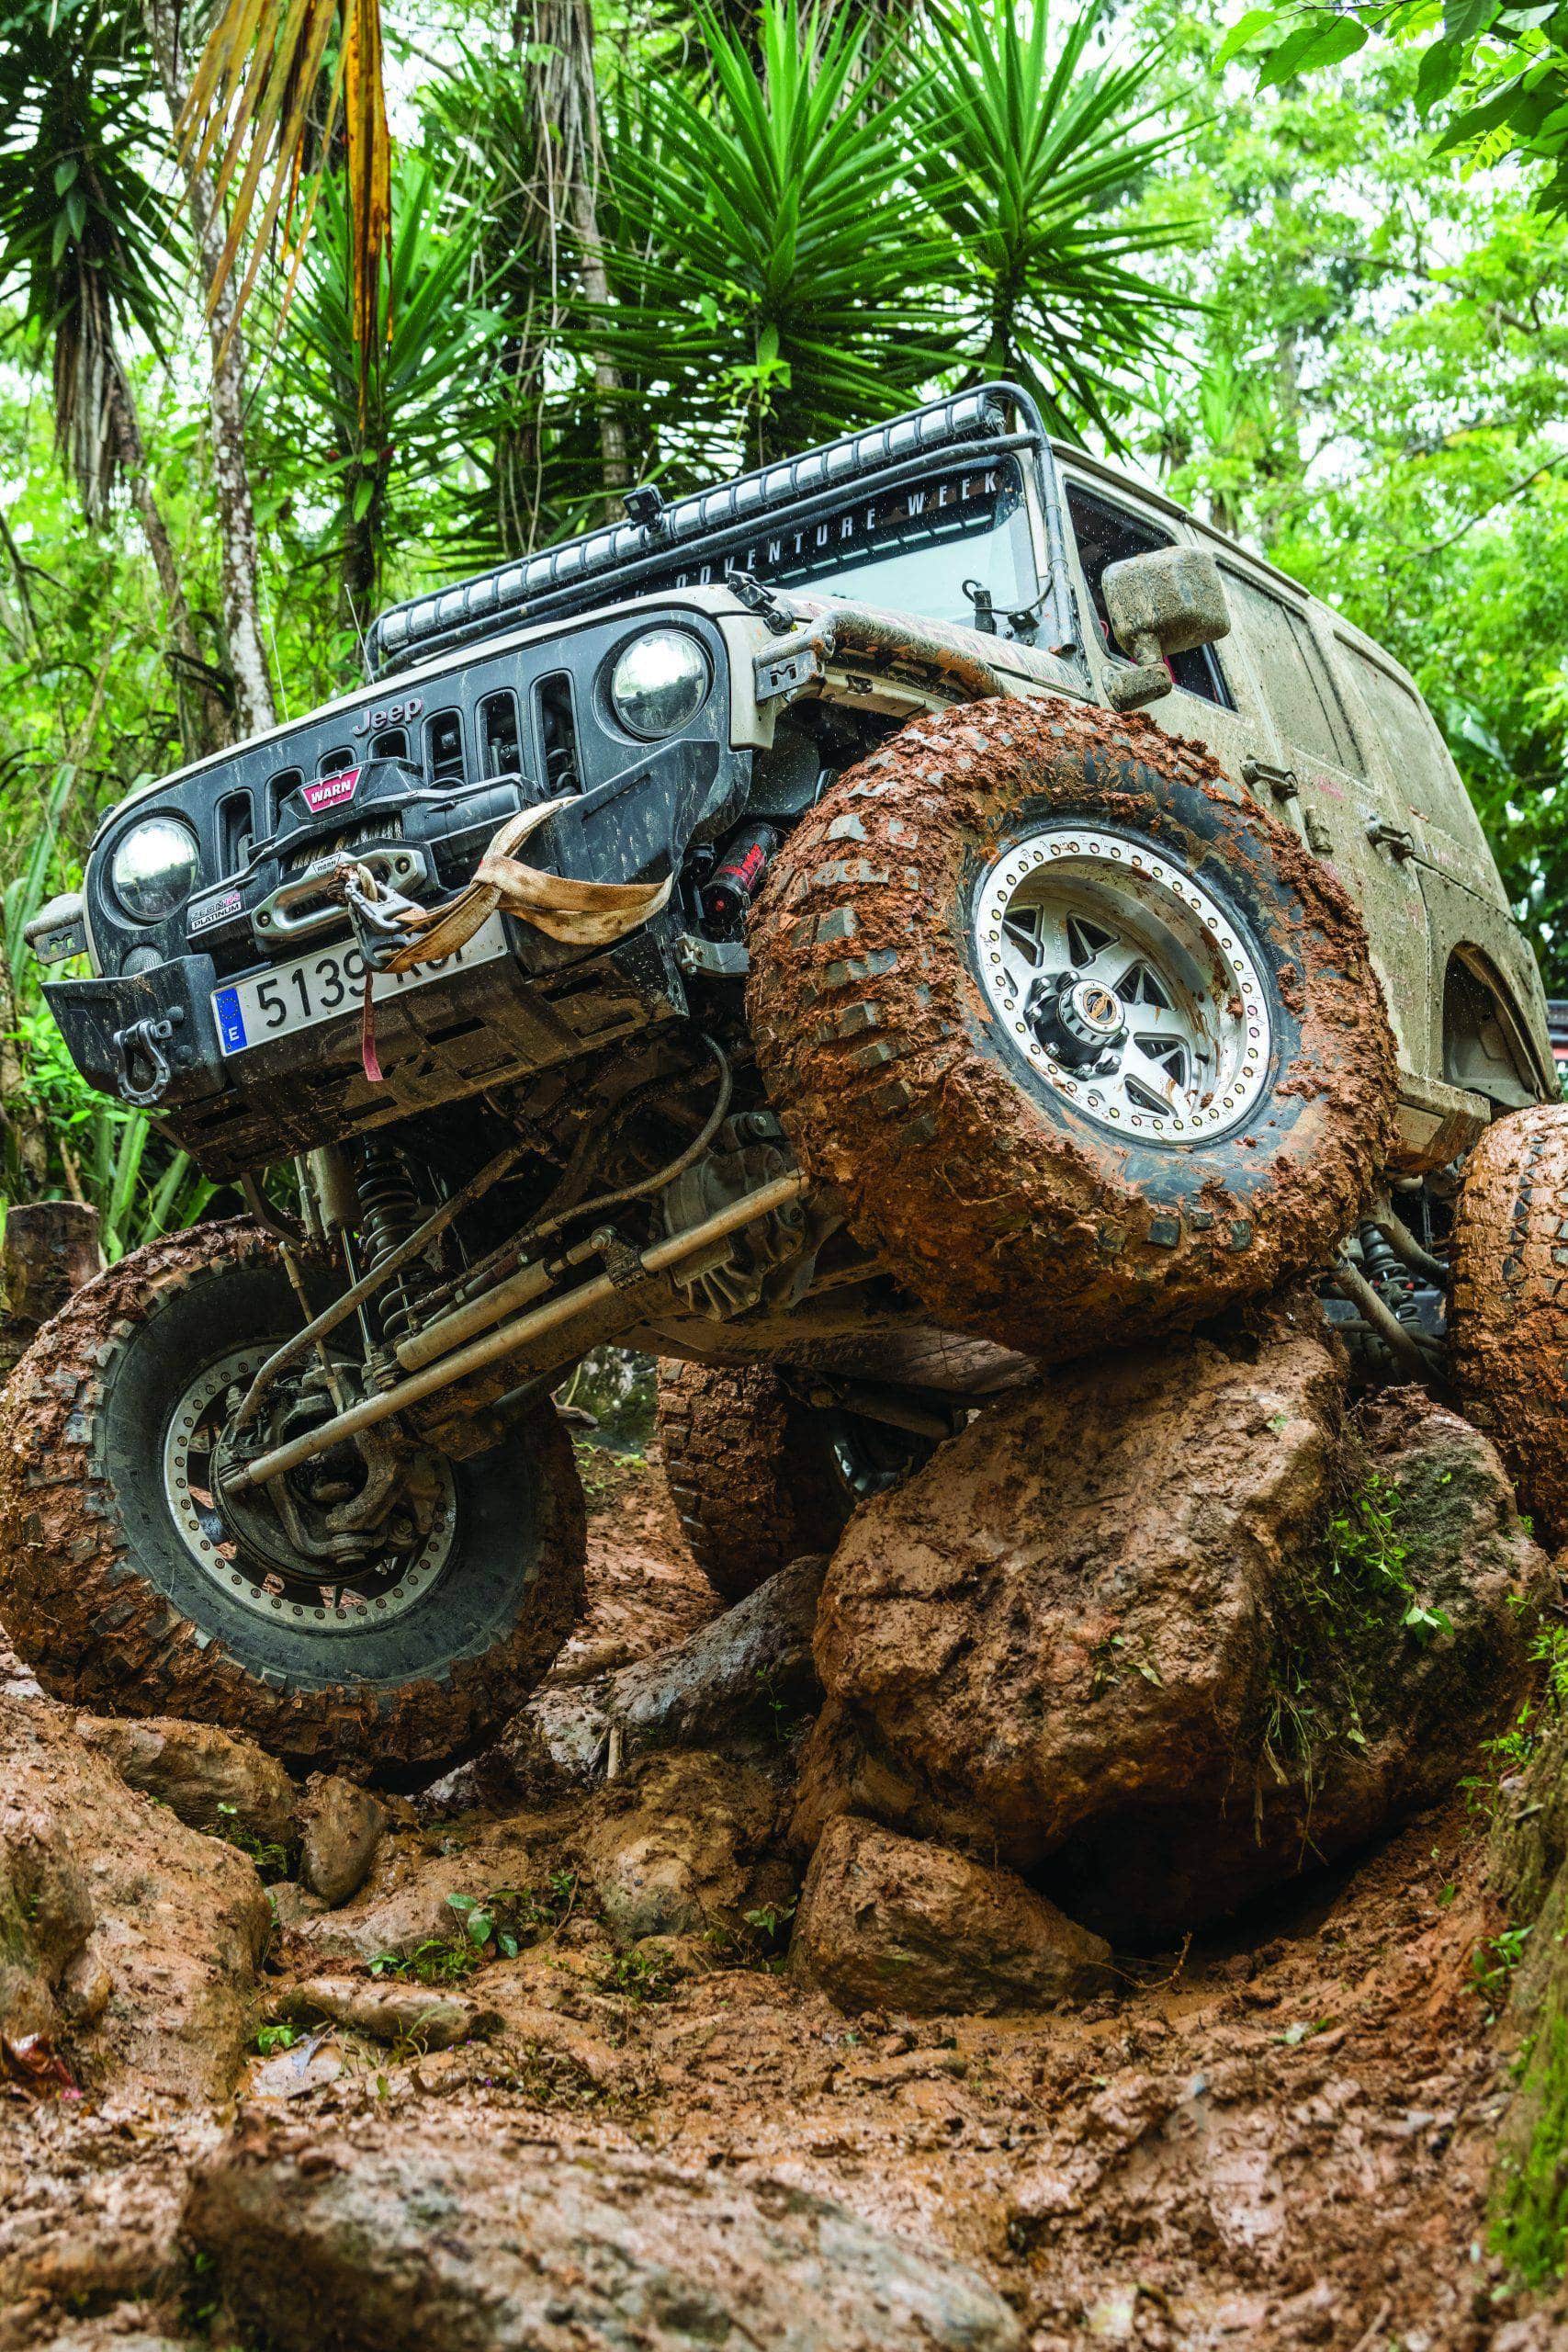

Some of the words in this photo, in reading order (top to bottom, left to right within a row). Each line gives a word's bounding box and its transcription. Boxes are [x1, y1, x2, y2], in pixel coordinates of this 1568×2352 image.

[908, 471, 997, 516] WEEK
[352, 697, 423, 737] Jeep
[310, 779, 352, 805] WARN
[193, 903, 240, 928] PLATINUM
[255, 947, 367, 1028] 5139
[228, 1025, 241, 1042] E
